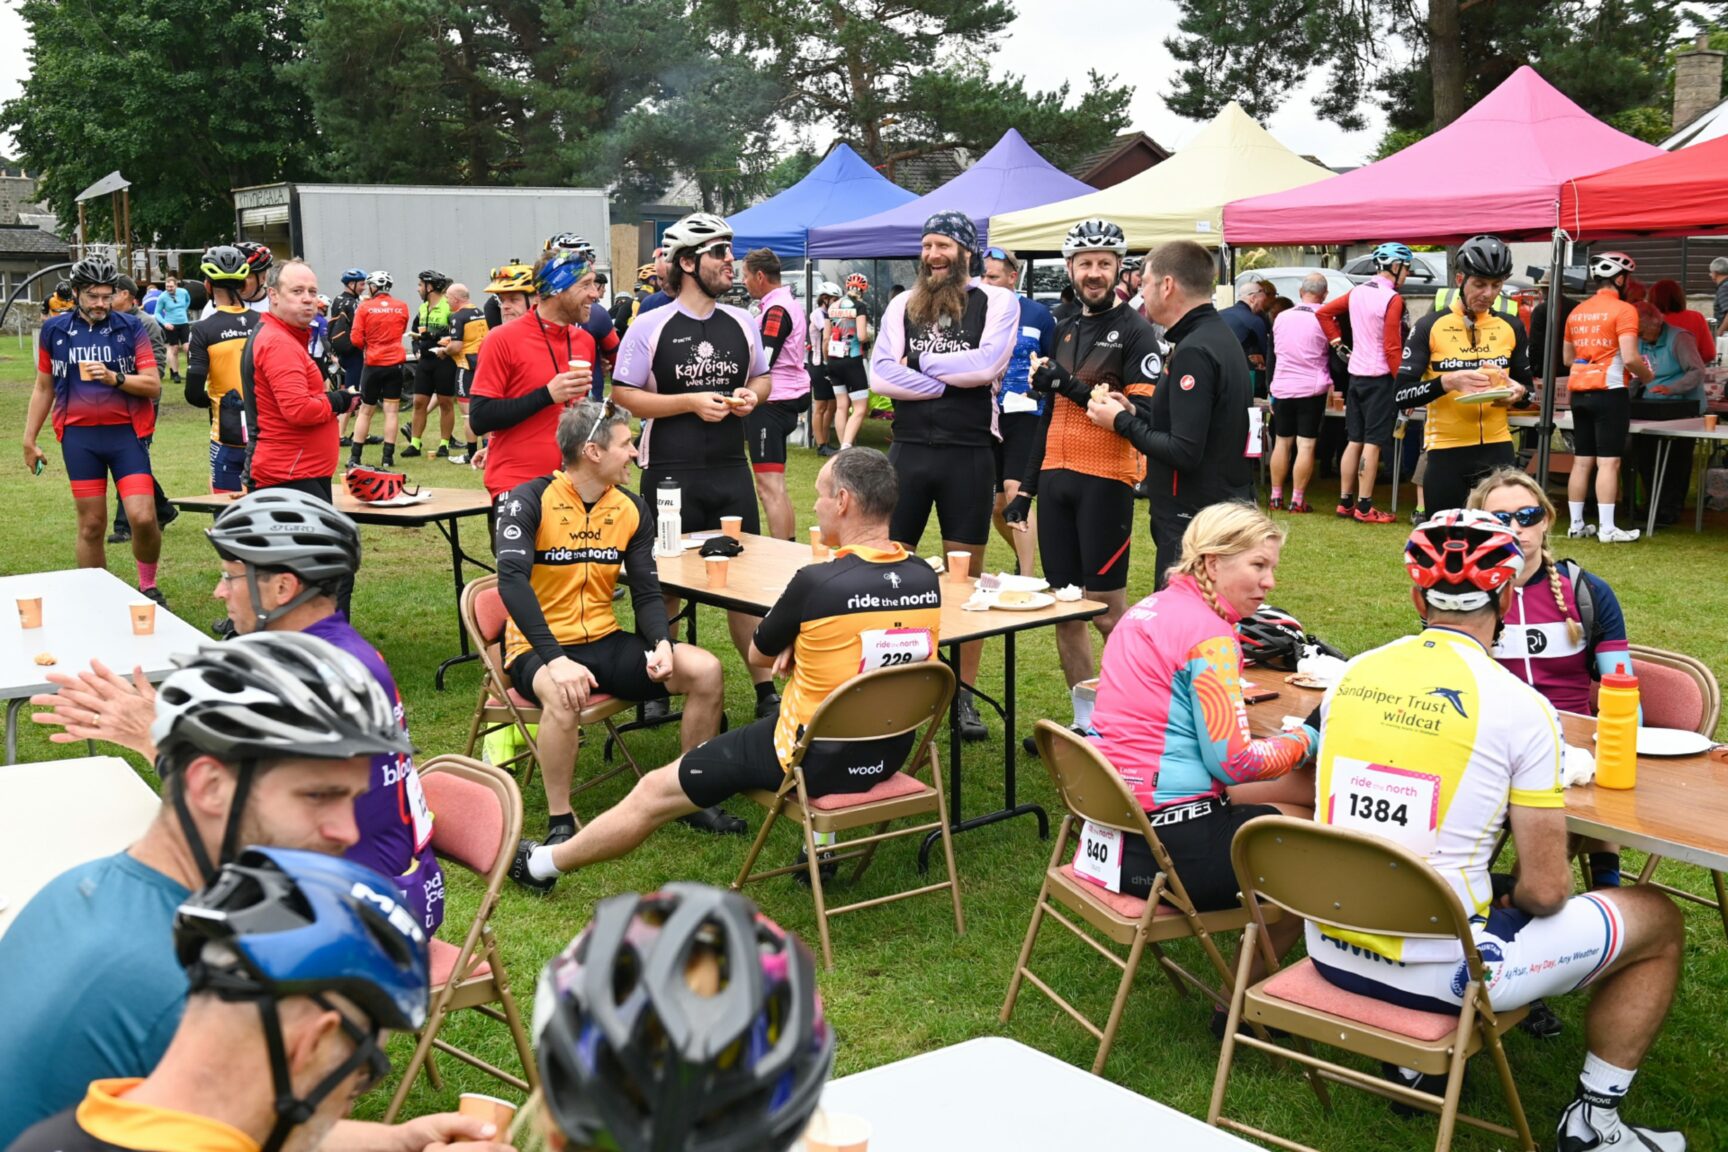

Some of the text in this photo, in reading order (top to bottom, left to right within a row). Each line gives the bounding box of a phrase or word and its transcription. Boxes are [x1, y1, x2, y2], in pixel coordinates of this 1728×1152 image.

[221, 329, 238, 339] ride
[1440, 358, 1464, 369] ride
[706, 375, 730, 387] Stars
[1395, 382, 1432, 402] carnac
[544, 547, 619, 561] ride the north
[847, 590, 938, 609] ride the north
[876, 640, 891, 649] ride
[900, 639, 919, 648] north
[1337, 684, 1447, 714] Sandpiper Trust
[1383, 708, 1443, 731] wildcat
[848, 760, 884, 775] wood
[1350, 776, 1373, 789] ride
[1385, 783, 1418, 798] north
[1349, 793, 1409, 828] 1384
[1086, 838, 1109, 864] 840
[1558, 955, 1572, 965] Any
[1573, 947, 1600, 961] Weather
